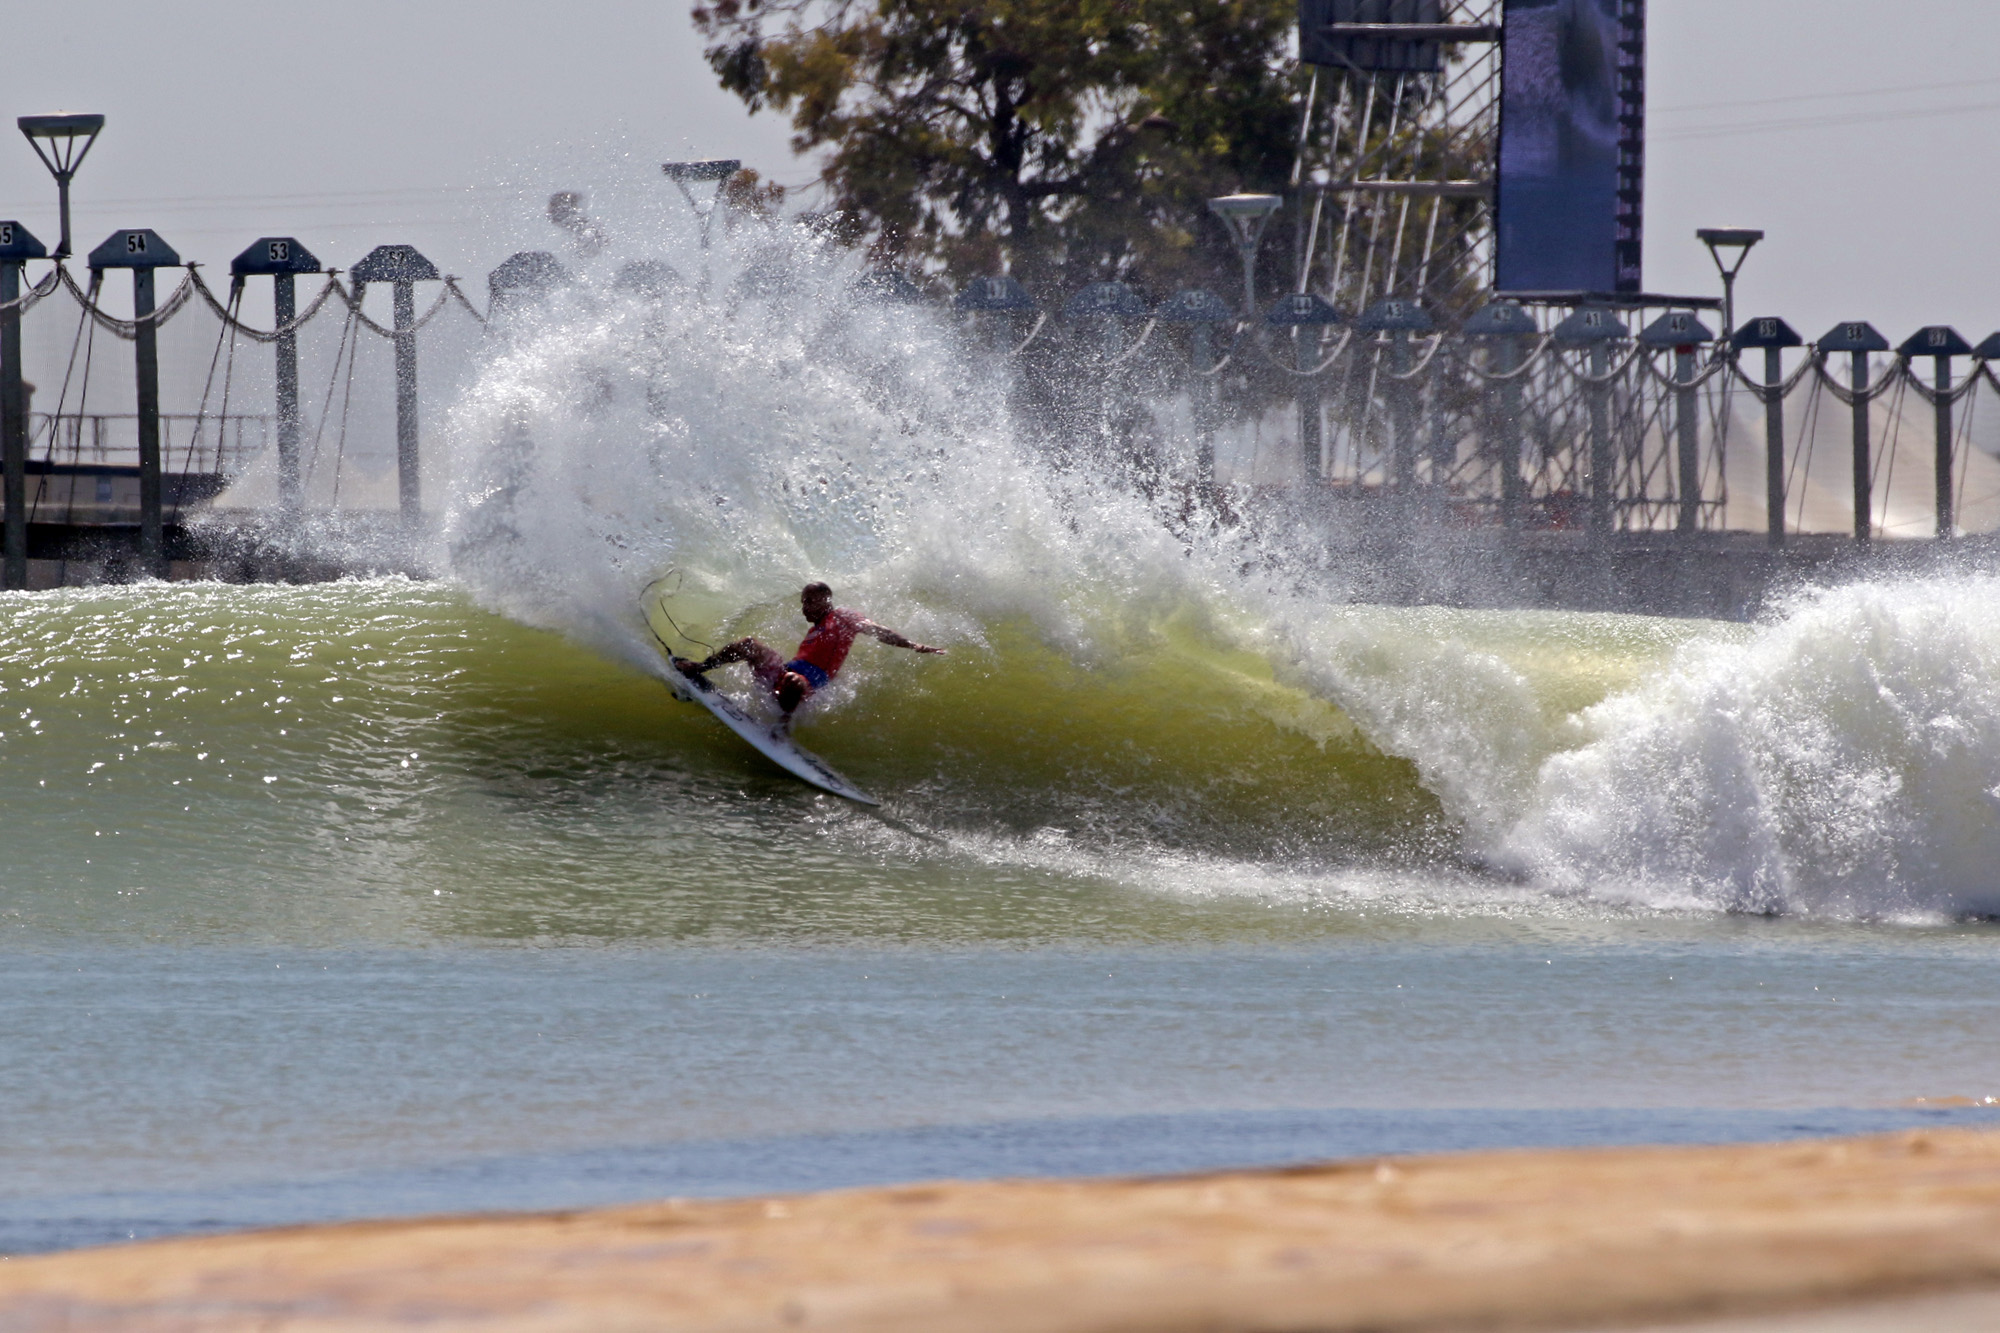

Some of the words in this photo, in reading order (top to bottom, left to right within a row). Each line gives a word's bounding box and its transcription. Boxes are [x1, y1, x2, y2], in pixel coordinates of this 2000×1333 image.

[0, 227, 11, 244] 5
[128, 235, 145, 252] 54
[270, 243, 287, 259] 53
[1761, 321, 1775, 335] 39
[1930, 330, 1945, 345] 37
